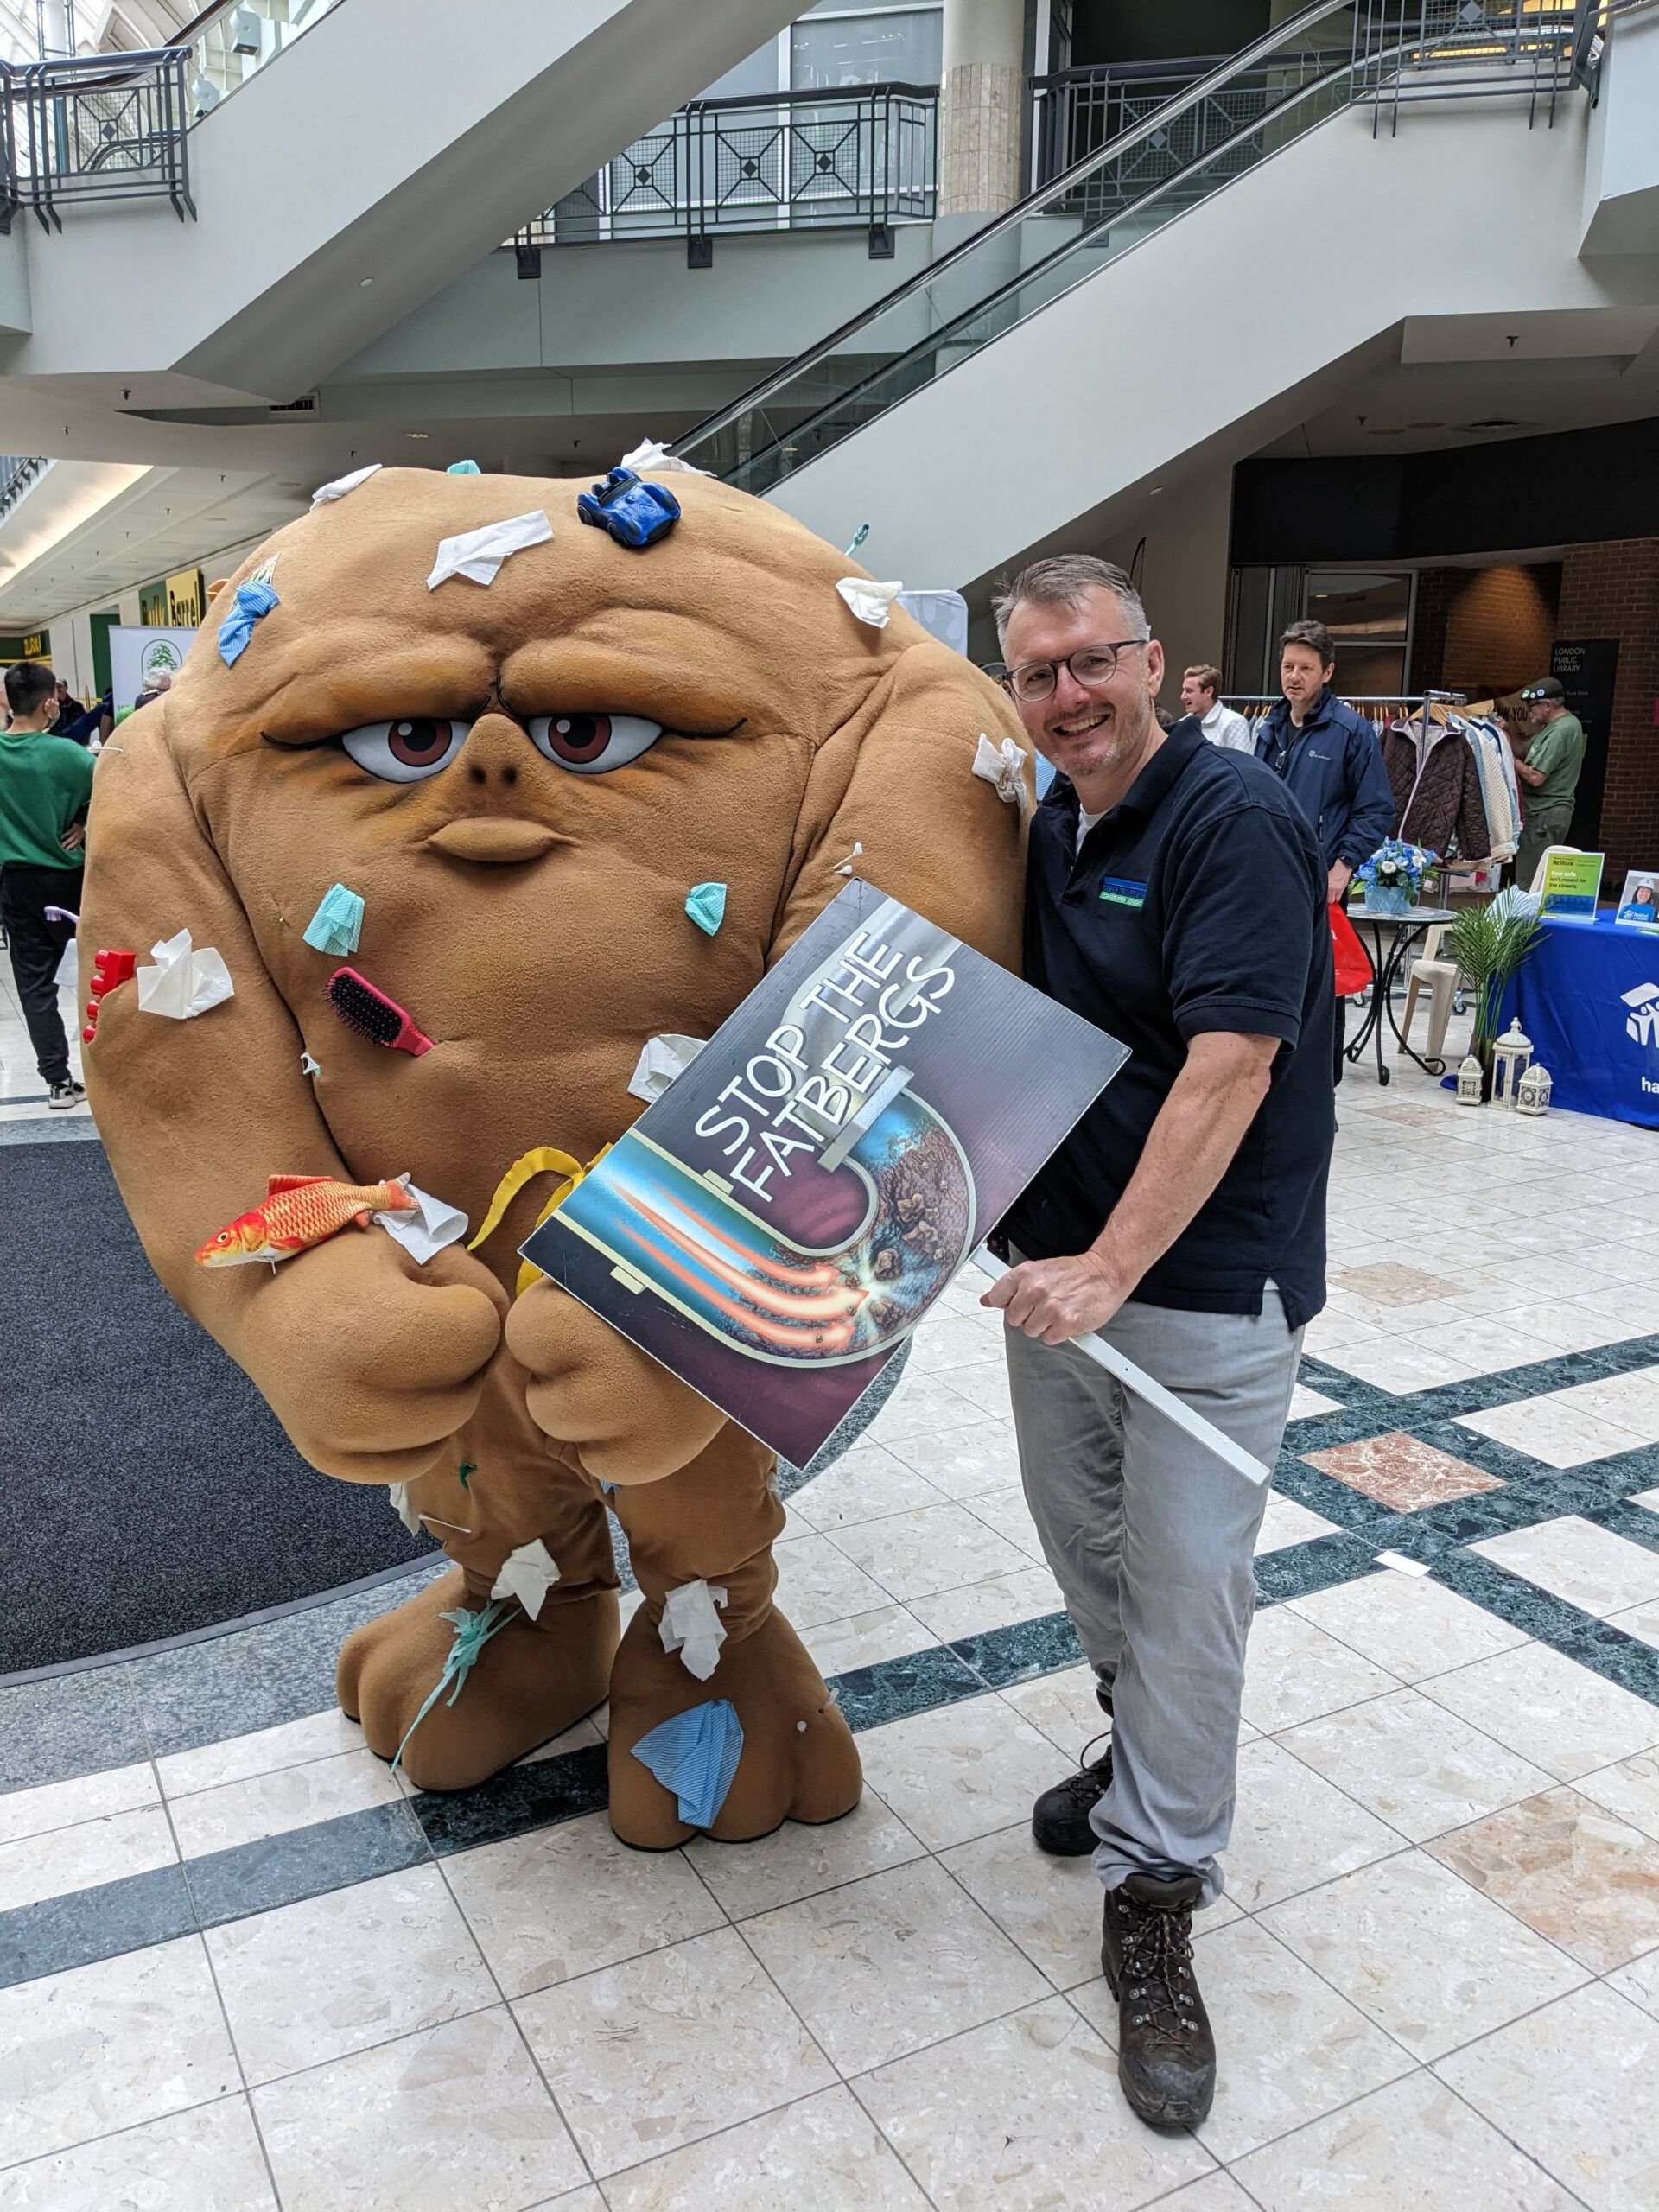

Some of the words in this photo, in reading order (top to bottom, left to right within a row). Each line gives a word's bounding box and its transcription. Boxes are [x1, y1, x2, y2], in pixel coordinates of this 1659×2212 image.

[170, 581, 200, 627] Barrel
[1512, 706, 1529, 722] YOU
[695, 1023, 809, 1157] STOP
[798, 931, 905, 1025] THE
[728, 955, 956, 1203] FATBERGS
